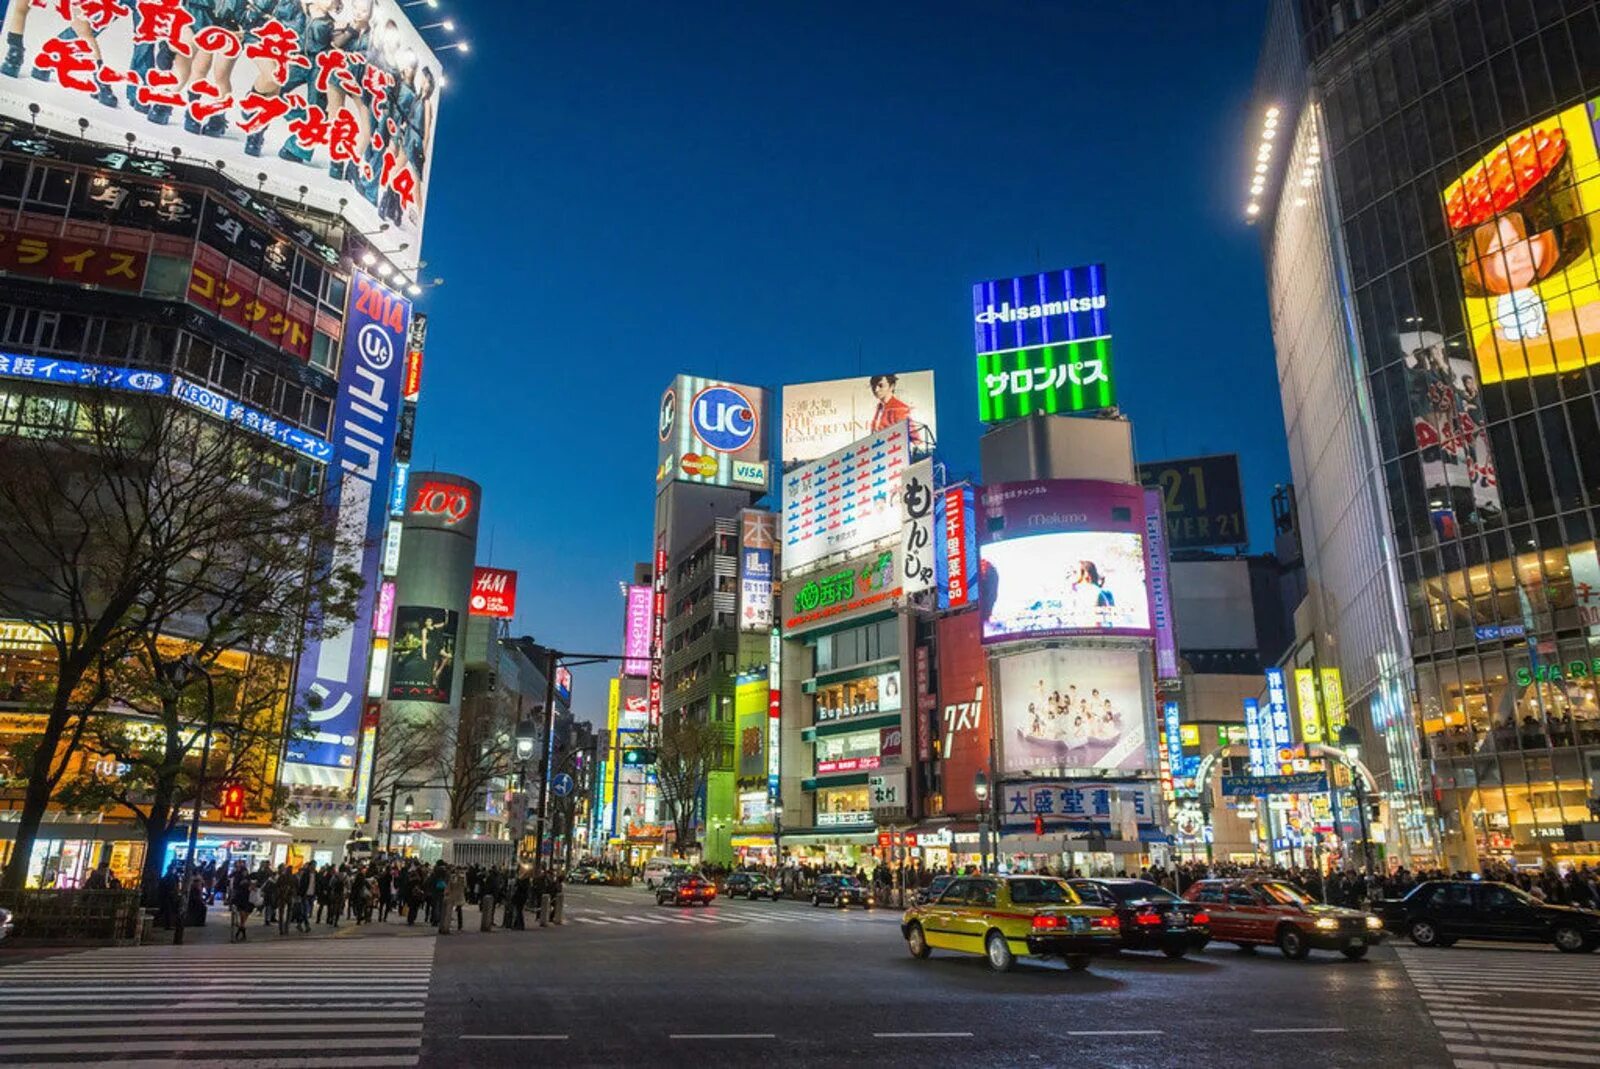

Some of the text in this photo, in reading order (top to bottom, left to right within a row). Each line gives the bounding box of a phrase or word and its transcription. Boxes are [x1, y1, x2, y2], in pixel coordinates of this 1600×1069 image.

[0, 235, 138, 280] ライス
[190, 267, 310, 347] コンタクト
[355, 279, 404, 334] 2014
[975, 294, 1107, 325] Hisamitsu
[983, 359, 1108, 397] サロンパス
[698, 400, 752, 437] UC
[737, 467, 764, 479] VISA
[410, 483, 473, 525] 109
[904, 477, 933, 585] もんじゃ
[946, 494, 963, 598] 三千里薬品
[476, 572, 508, 594] H&M
[627, 588, 646, 672] Essential
